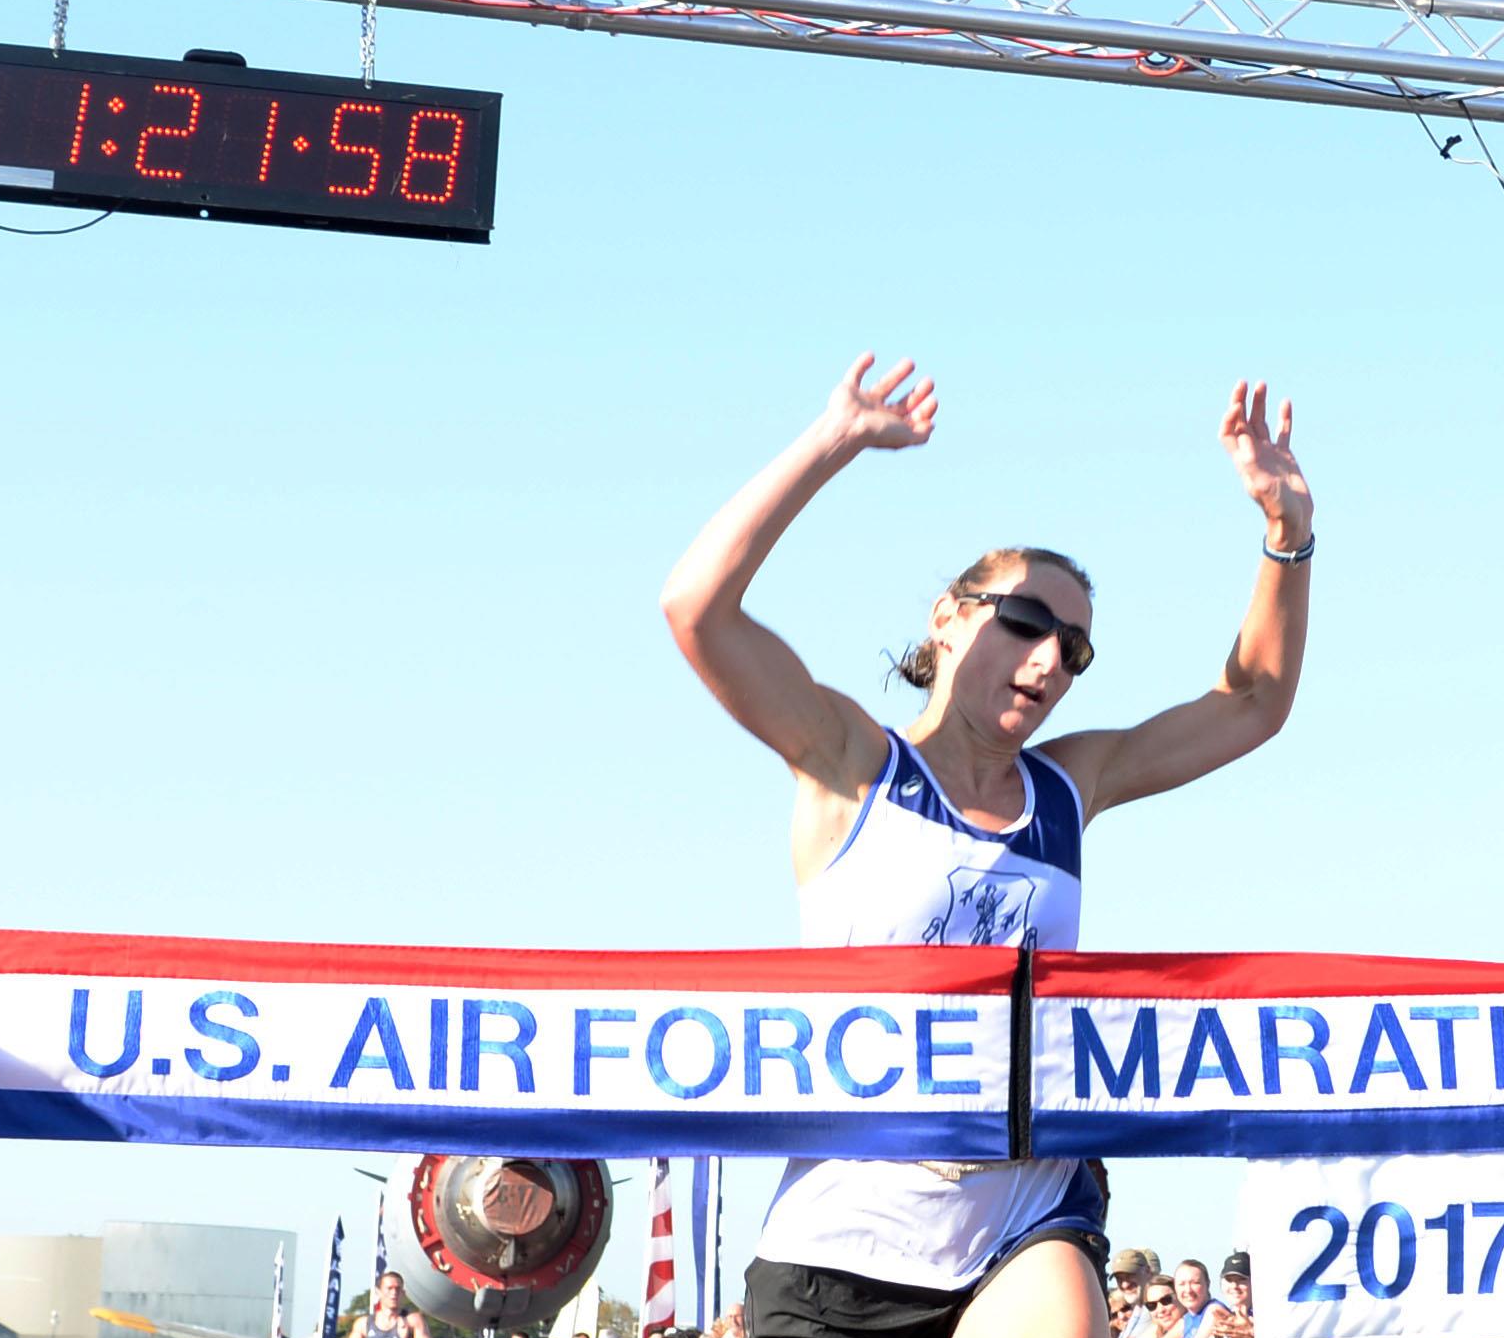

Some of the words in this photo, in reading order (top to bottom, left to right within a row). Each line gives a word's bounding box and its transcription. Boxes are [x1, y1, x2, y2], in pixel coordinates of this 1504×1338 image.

[69, 988, 290, 1083] U.S.
[329, 996, 536, 1094] AIR
[573, 1006, 980, 1099] FORCE
